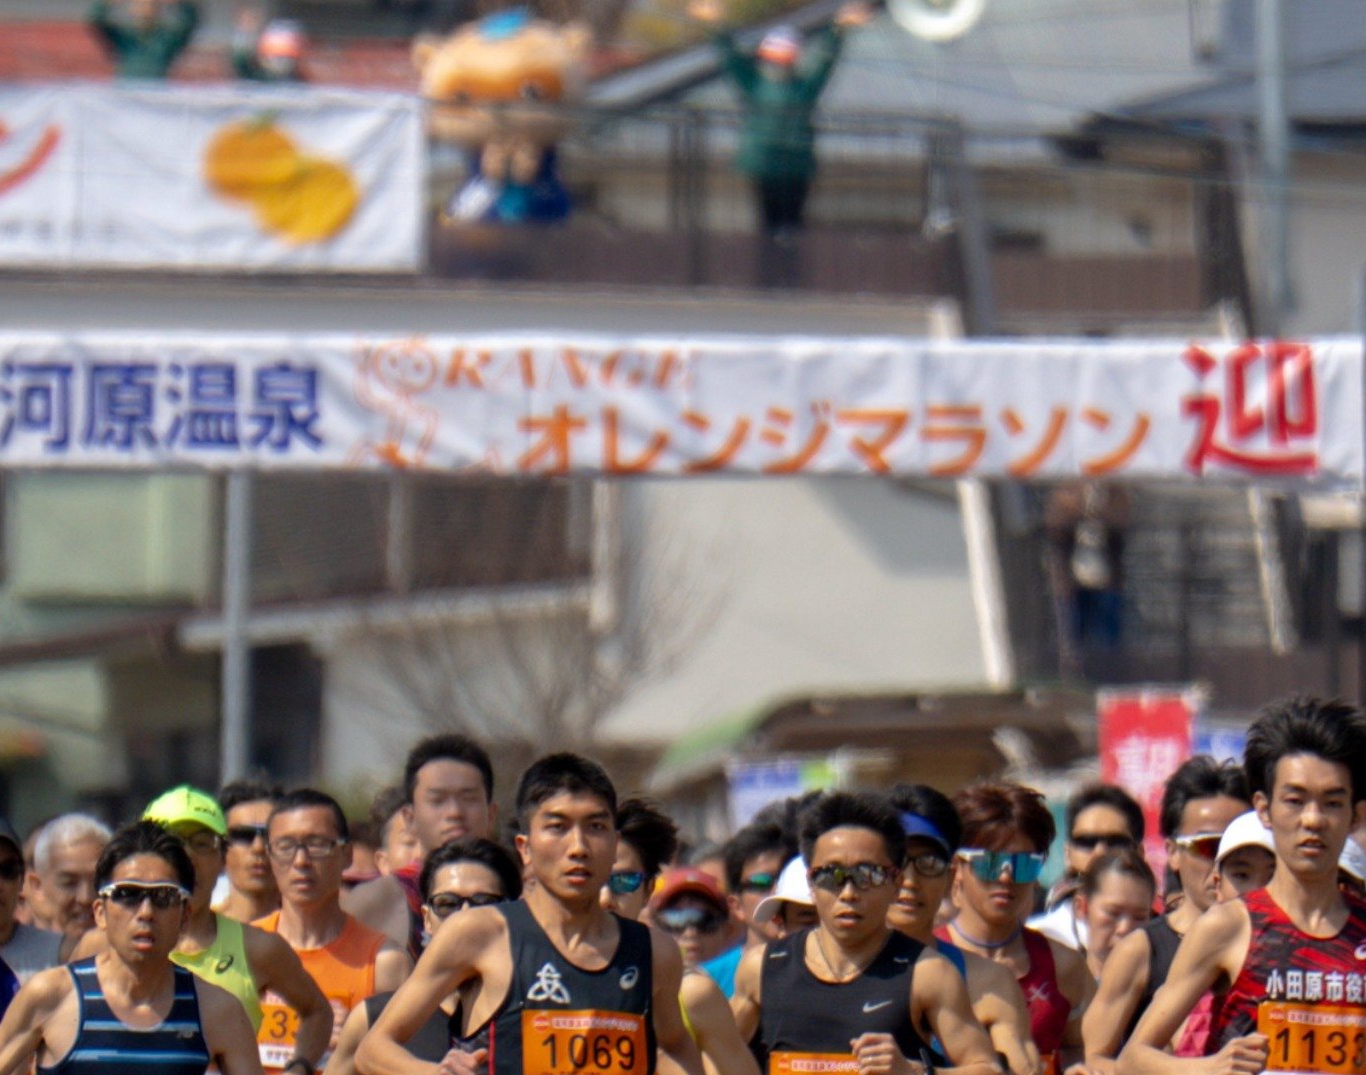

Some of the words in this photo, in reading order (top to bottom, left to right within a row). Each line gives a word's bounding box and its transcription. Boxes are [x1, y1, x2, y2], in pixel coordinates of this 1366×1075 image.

[1180, 344, 1318, 476] 迎
[516, 402, 1151, 476] オレンジマラソン
[542, 1033, 635, 1071] 1069
[1276, 1027, 1366, 1068] 1133
